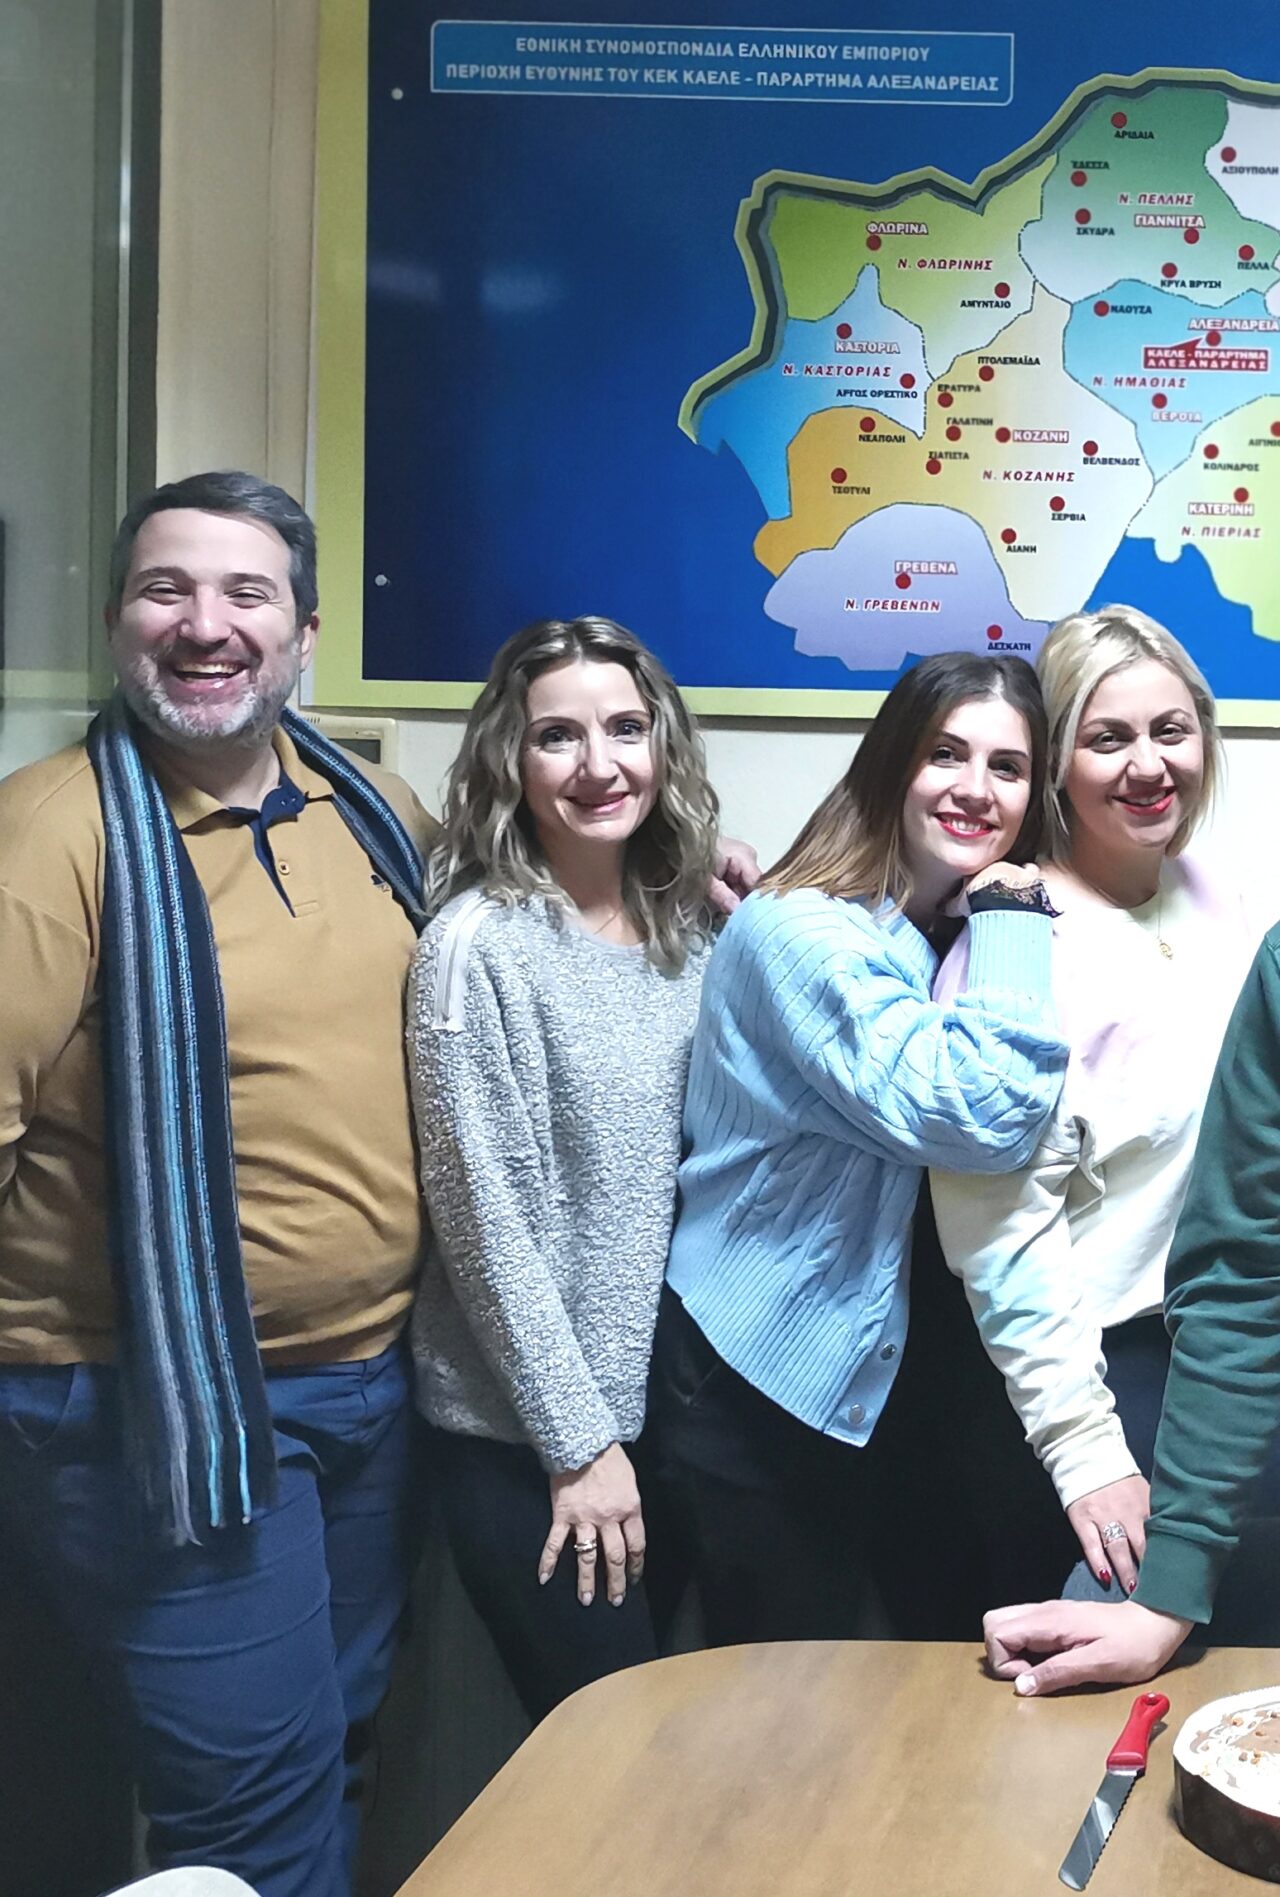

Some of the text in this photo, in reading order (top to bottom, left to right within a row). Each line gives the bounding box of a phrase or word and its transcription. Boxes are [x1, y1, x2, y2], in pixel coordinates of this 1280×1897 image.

[515, 37, 931, 62] ΕΘΝΙΚΗ ΣΥΝΟΜΟΣΠΟΝΔΙΑ ΕΛΛΗΝΙΚΟΥ ΕΜΠΟΡΙΟΥ
[446, 64, 522, 81] ΠΕΡΙΟΧΗ
[525, 65, 604, 83] ΕΥΘΥΝΗΣ
[607, 66, 640, 83] ΤΟΥ
[644, 67, 679, 85] ΚΕΚ
[682, 68, 741, 86] ΚΑΕΛΕ
[756, 71, 864, 90] ΠΑΡΑΡΤΗΜΑ
[867, 74, 1000, 92] ΑΛΕΞΑΝΔΡΕΙΑΣ
[1222, 166, 1279, 175] ΑΞΙΟΥΠΟΛΗ
[1138, 194, 1195, 206] ΠΕΛΛΗΣ
[1134, 213, 1206, 229] ΓΙΑΝΝΙΤΣΑ
[866, 221, 929, 236] ΦΛΩΡΙΝΑ
[1076, 227, 1115, 236] ΣΚΥΔΡΑ
[917, 258, 994, 271] ΦΛΩΡΙΝΗΣ
[1237, 261, 1270, 271] ΠΕΛΛΑ
[1160, 279, 1187, 289] ΚΡΥΑ
[960, 300, 1011, 309] ΑΜΥΝΤΑΙΟ
[1188, 318, 1280, 333] ΑΛΕΞΑΝΔΡΕΙΑ
[834, 340, 901, 355] ΚΑΣΤΟΡΙΑ
[1147, 349, 1186, 359] ΚΑΕΛΕ
[1194, 350, 1267, 360] ΠΑΡΑΡΤΗΜΑ
[1147, 359, 1267, 370] ΑΛΕΞΑΝΔΡΕΙΑΣ
[803, 364, 892, 377] ΚΑΣΤΟΡΙΑΣ
[1113, 377, 1187, 388] ΗΜΑΘΙΑΣ
[869, 389, 918, 399] ΟΡΕΣΤΙΚΟ
[1152, 412, 1203, 423] ΒΕΡΟΙΑ
[1012, 430, 1069, 443] ΚΟΖΑΝΗ
[1082, 457, 1140, 466] ΒΕΛΒΕΝΔΟΣ
[1203, 462, 1260, 472] ΚΟΛΙΝΔΡΟΣ
[1003, 471, 1076, 482] ΚΟΖΑΝΗΣ
[1188, 502, 1255, 516] ΚΑΤΕΡΙΝΗ
[1201, 527, 1262, 538] ΠΙΕΡΙΑΣ
[894, 560, 958, 575] ΓΡΕΒΕΝΑ
[863, 600, 941, 612] ΓΡΕΒΕΝΩΝ
[987, 641, 1032, 652] ΔΕΣΚΑΤΗ
